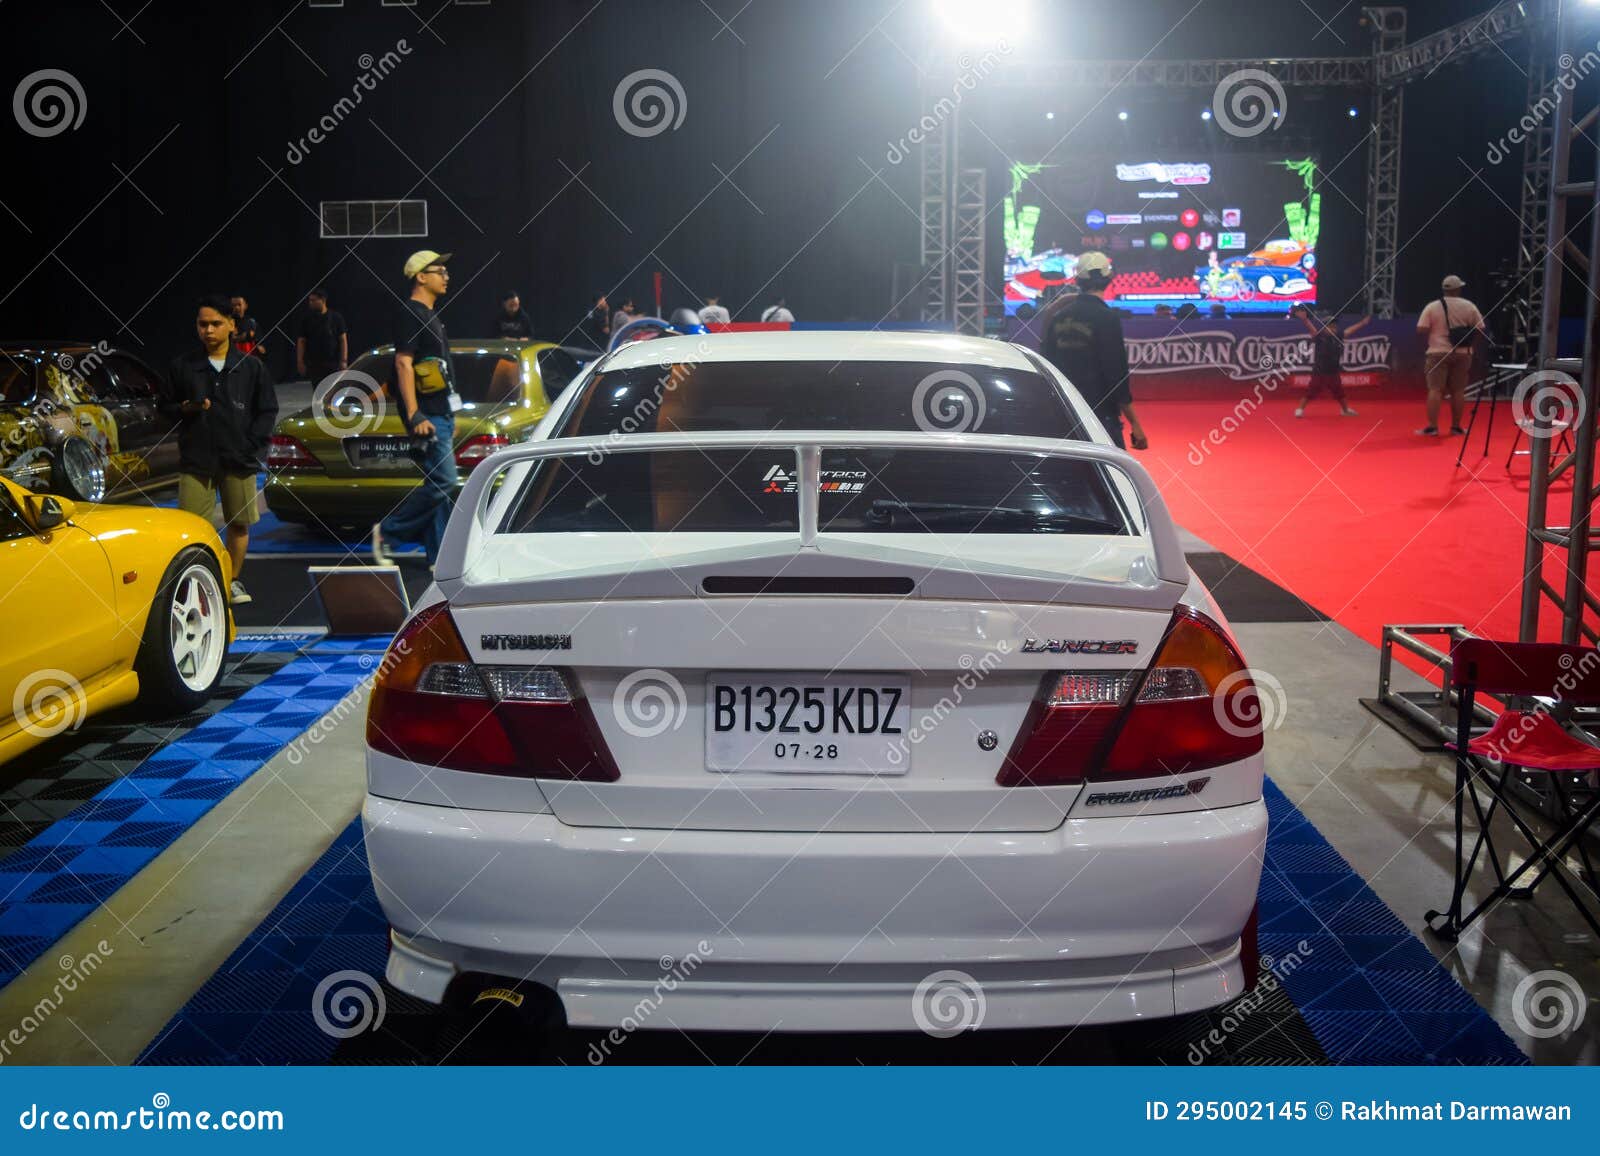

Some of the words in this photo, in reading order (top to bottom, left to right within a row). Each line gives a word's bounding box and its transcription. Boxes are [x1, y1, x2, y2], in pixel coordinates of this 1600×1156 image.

[1125, 341, 1232, 365] DONESIAN
[1340, 341, 1391, 365] HOW
[481, 635, 573, 650] MITSUBISHI
[1021, 639, 1139, 654] LANCER
